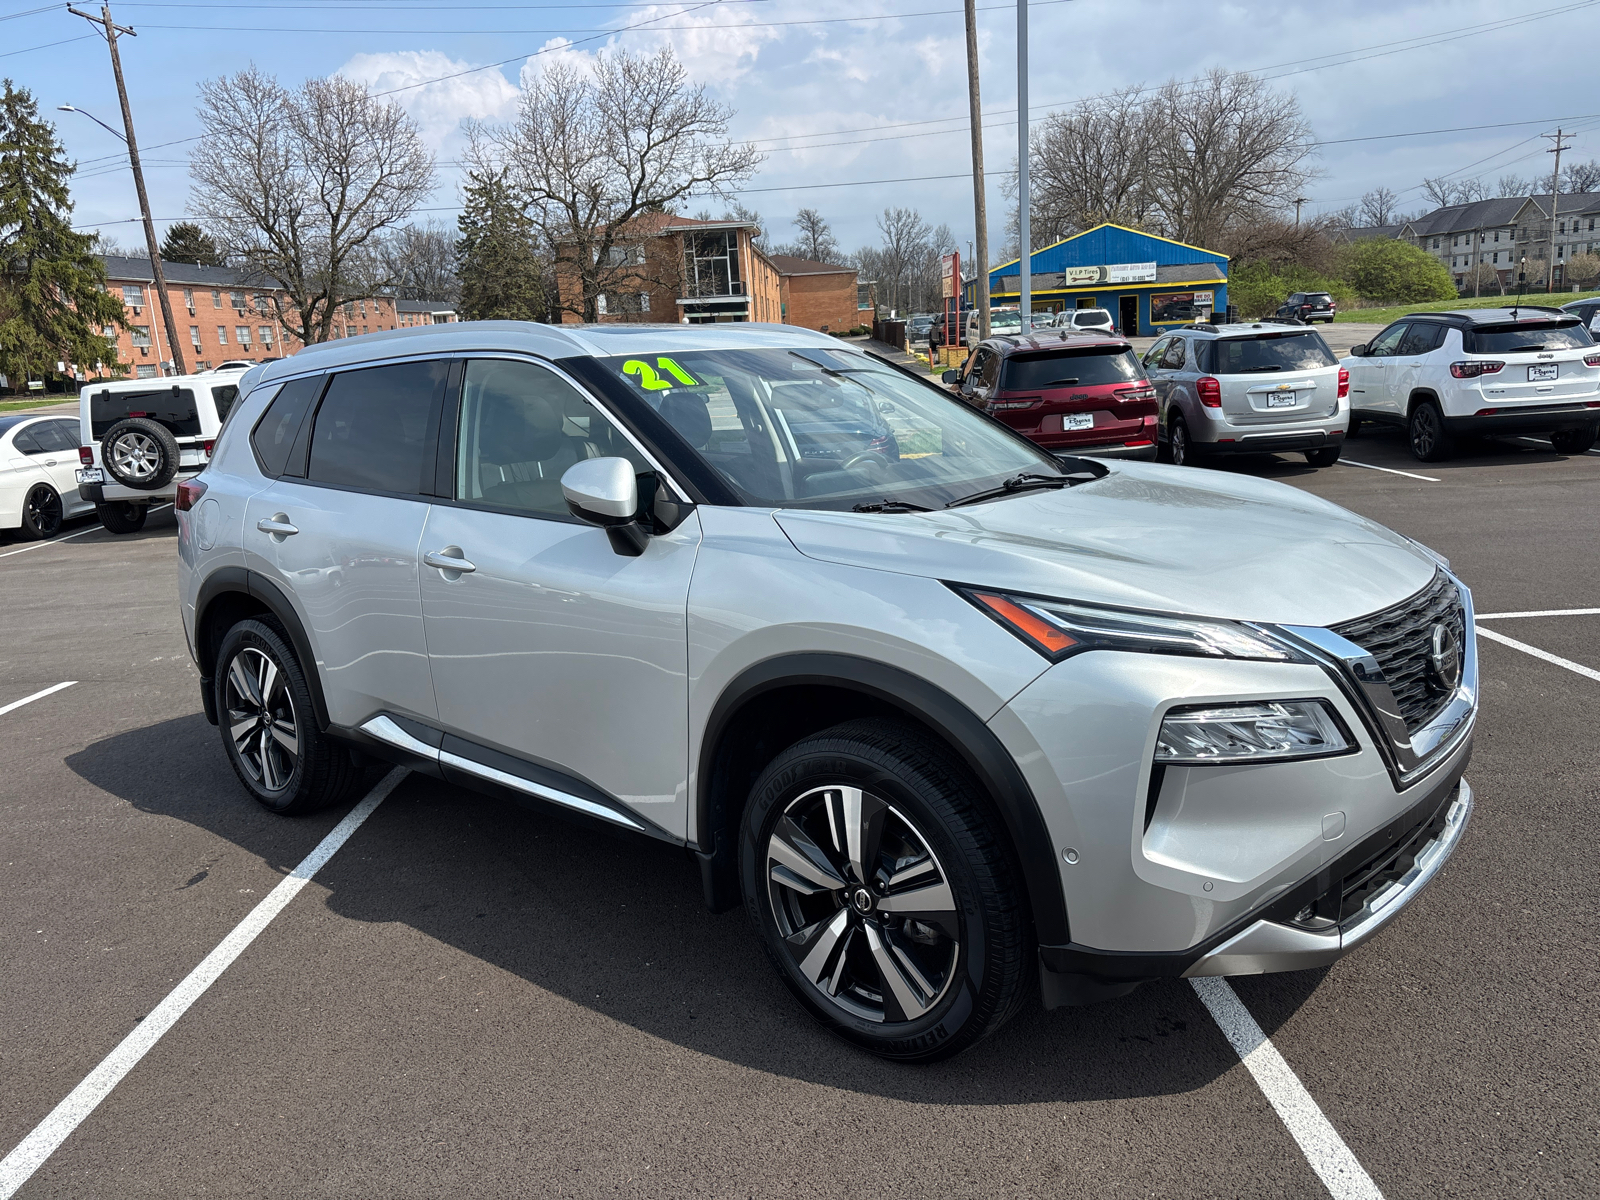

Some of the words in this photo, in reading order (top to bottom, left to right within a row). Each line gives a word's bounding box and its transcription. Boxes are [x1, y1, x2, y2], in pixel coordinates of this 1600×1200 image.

[622, 357, 699, 390] 21
[758, 758, 847, 811] GOODYEAR
[880, 1022, 949, 1053] RELIAN
